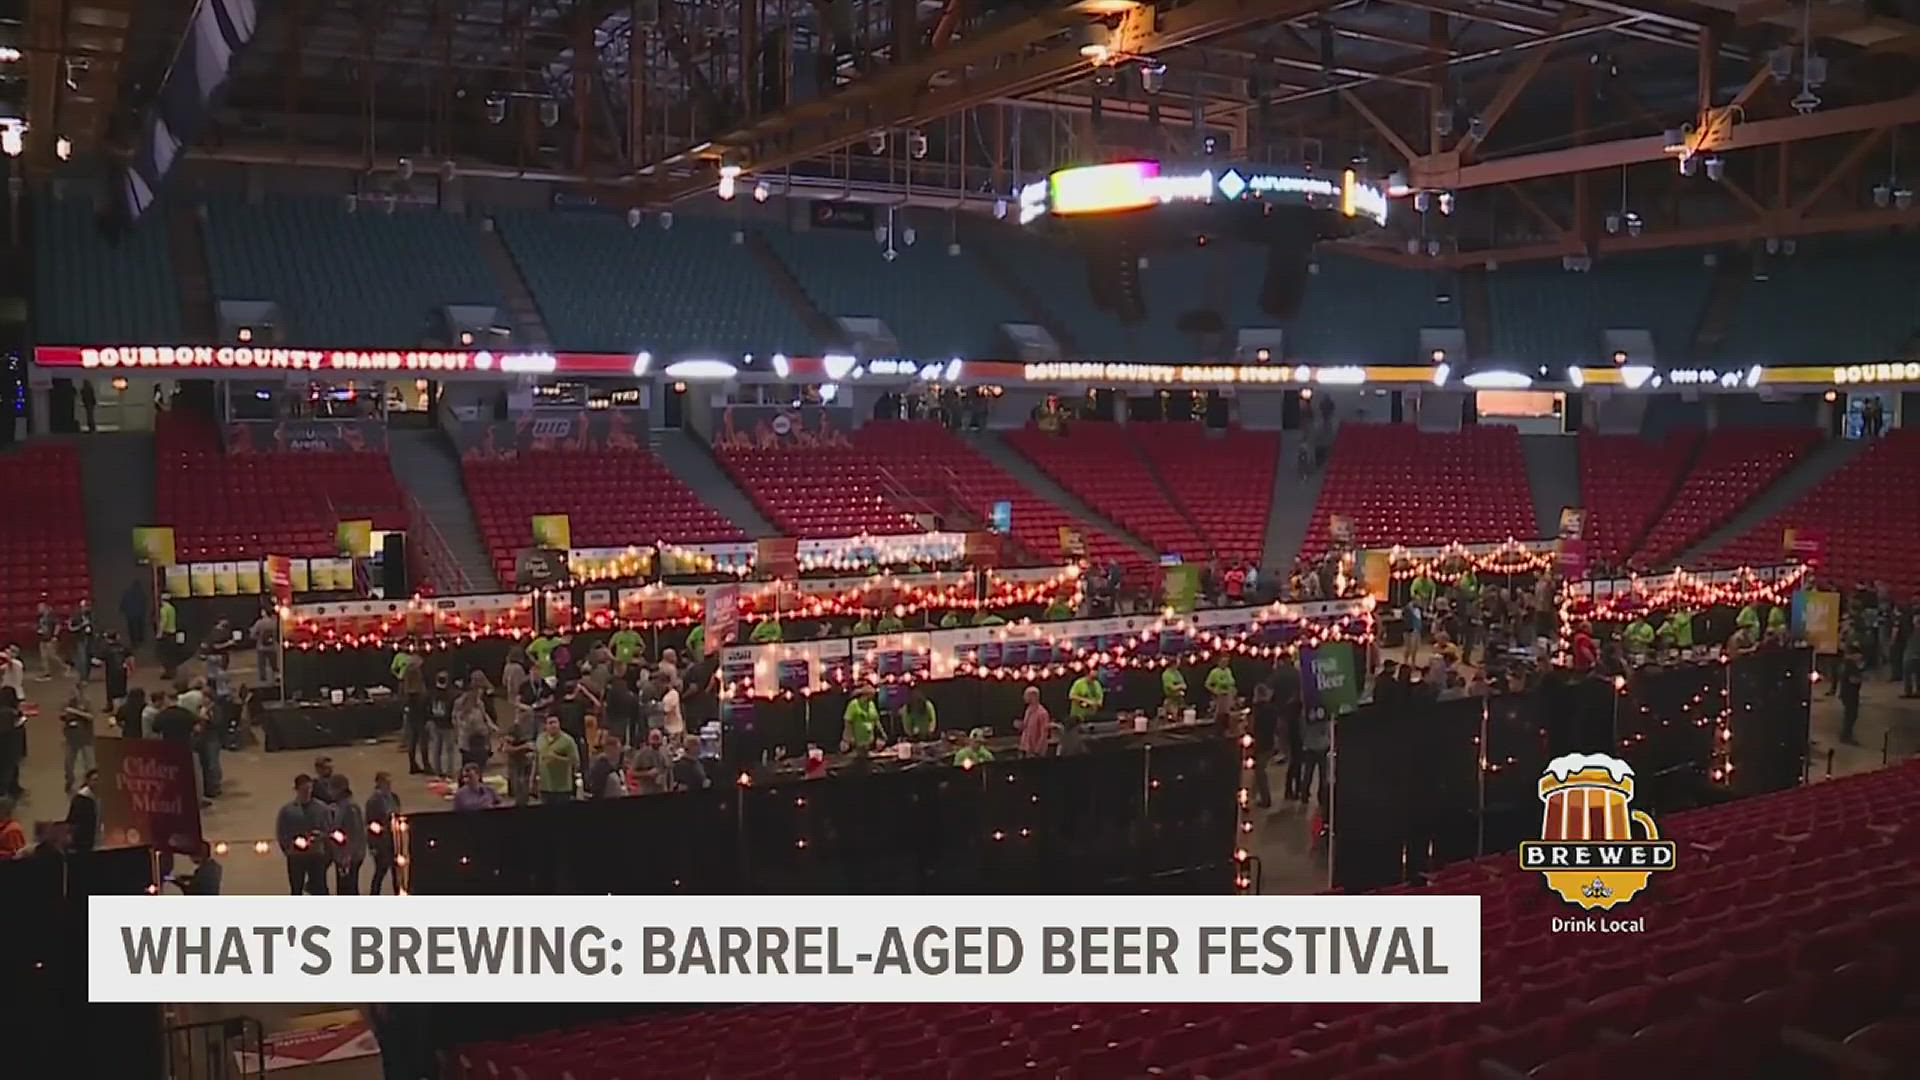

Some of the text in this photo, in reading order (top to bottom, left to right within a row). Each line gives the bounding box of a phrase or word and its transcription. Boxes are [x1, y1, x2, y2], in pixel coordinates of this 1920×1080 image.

[81, 347, 212, 368] BOURBON
[217, 348, 323, 369] COUNTY
[406, 352, 467, 370] STOUT
[1024, 363, 1103, 380] BOURBON
[1105, 363, 1175, 382] COUNTY
[1316, 673, 1345, 691] Beer
[123, 755, 179, 780] Cider
[115, 773, 165, 796] Perry
[132, 794, 183, 815] Mead
